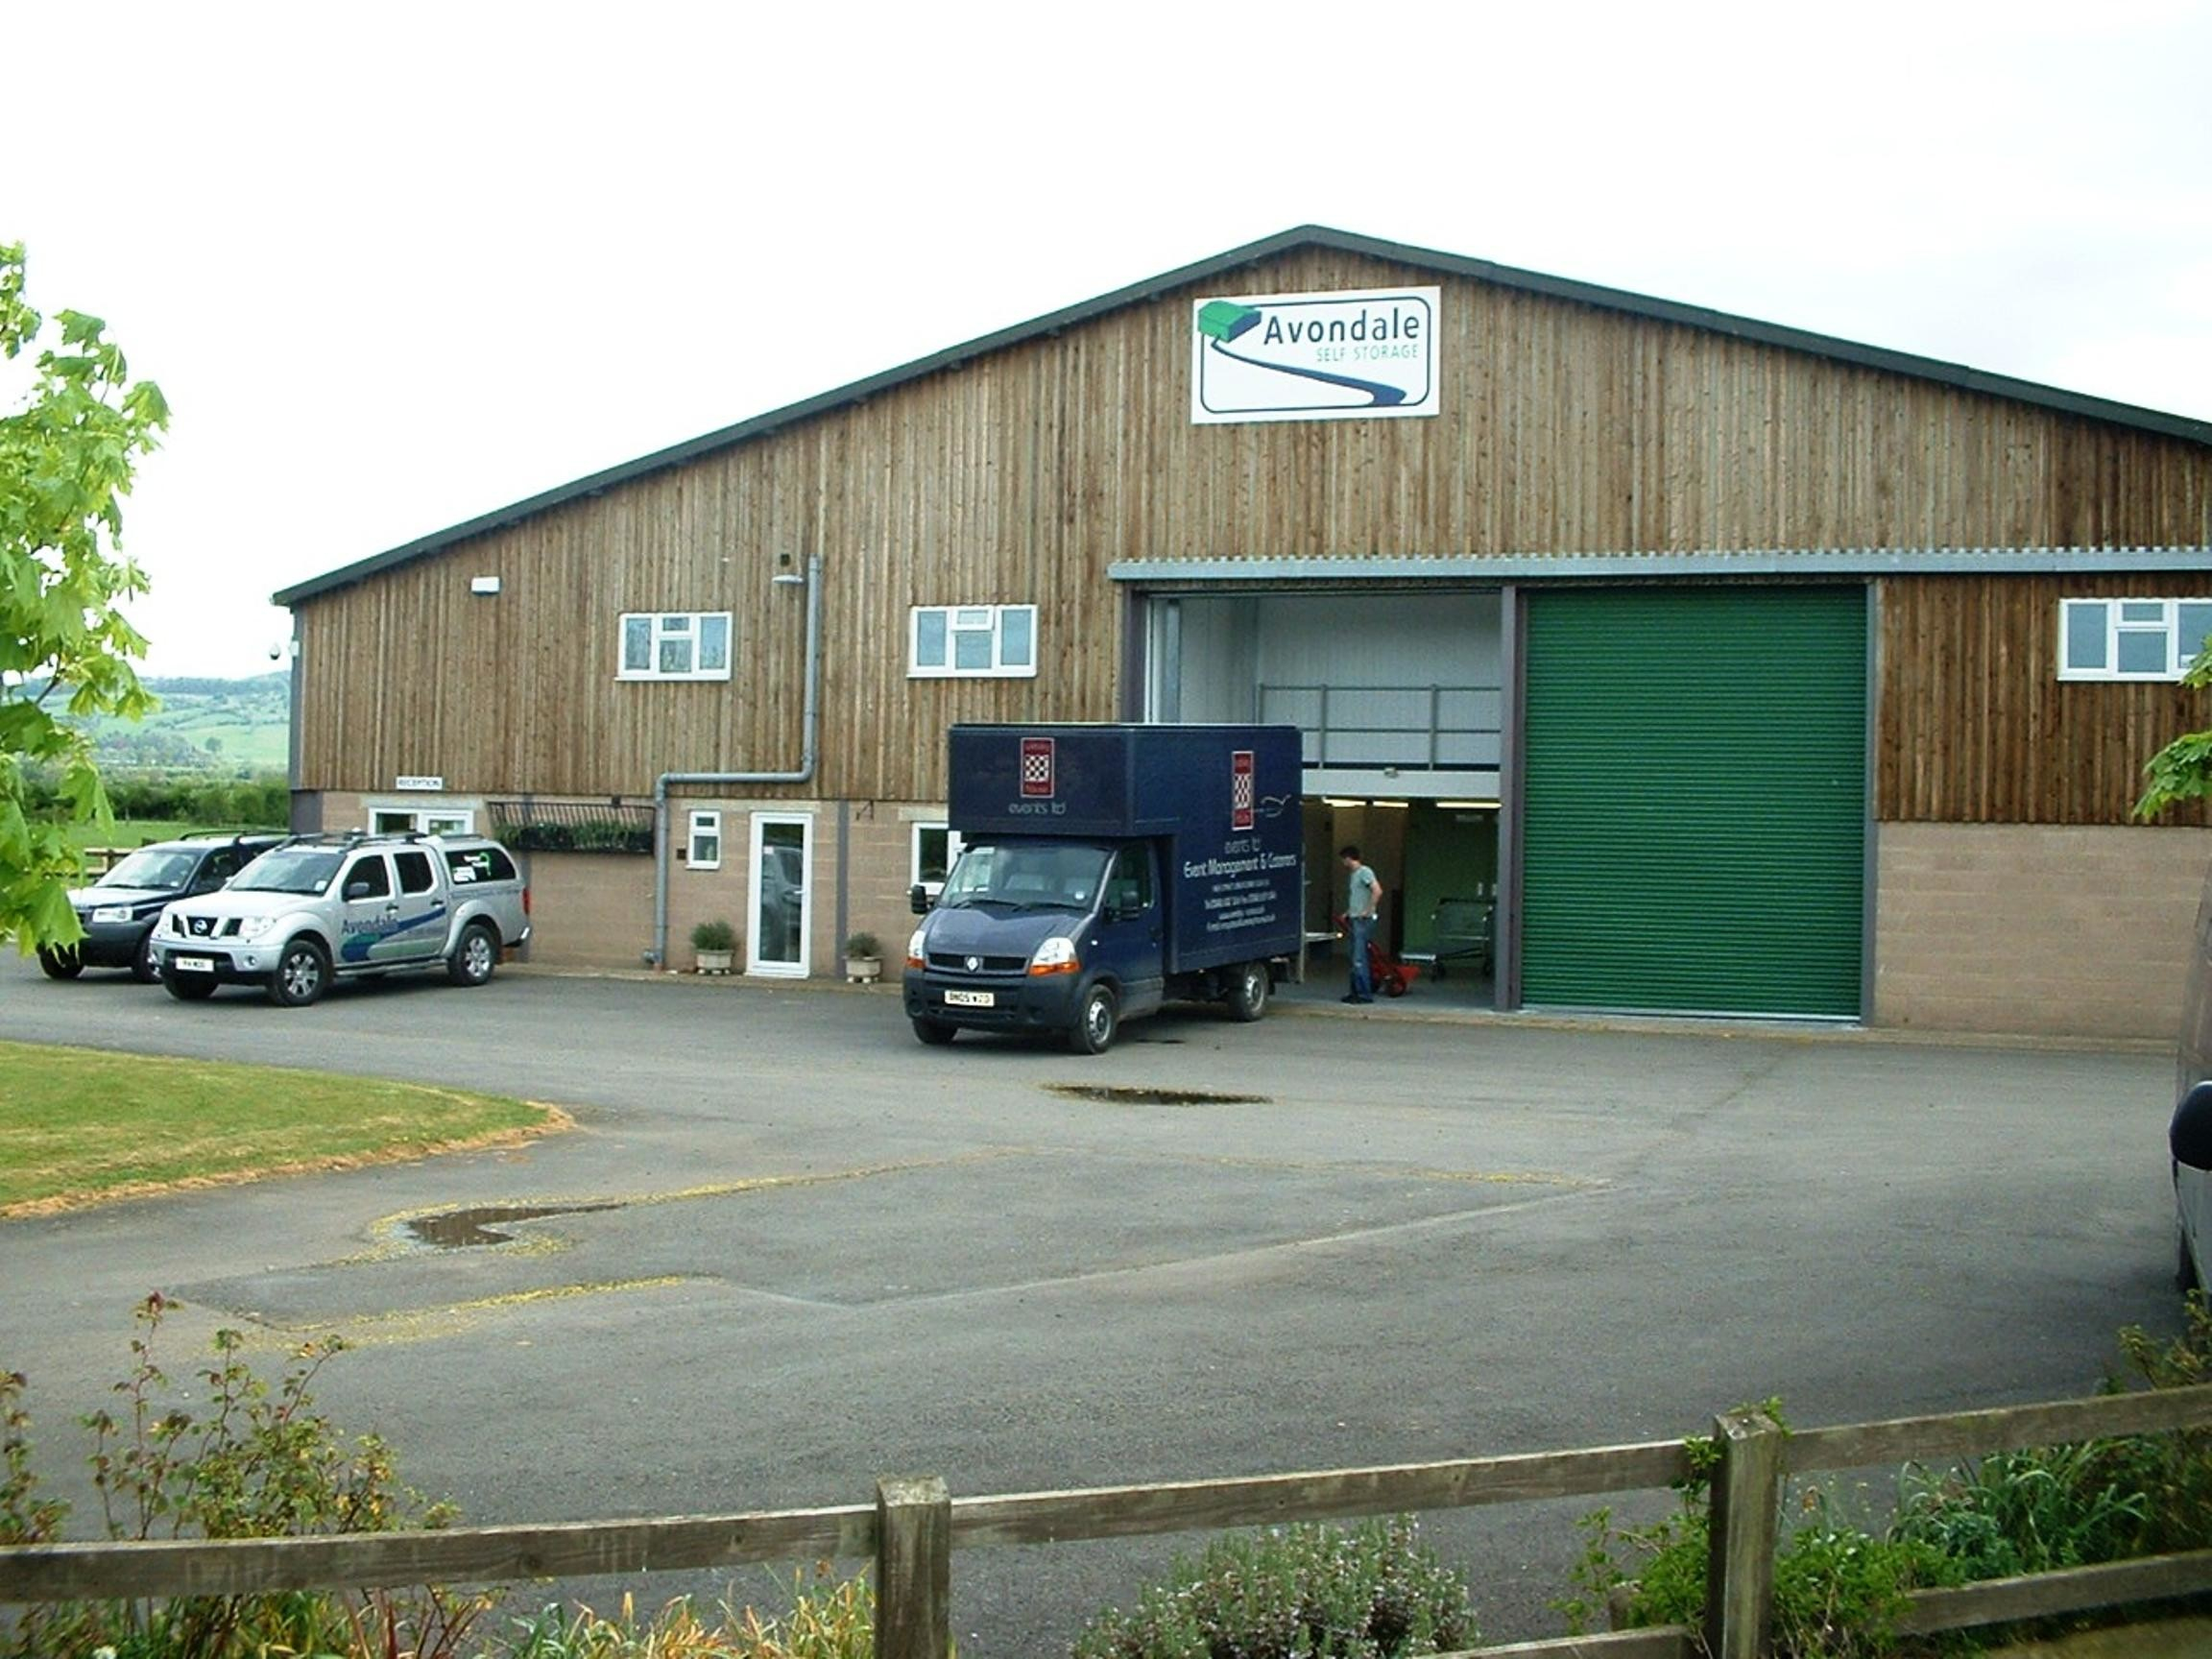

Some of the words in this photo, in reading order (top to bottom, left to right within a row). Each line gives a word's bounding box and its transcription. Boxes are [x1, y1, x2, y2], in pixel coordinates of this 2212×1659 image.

[1263, 307, 1420, 345] Avondale
[1316, 346, 1346, 362] SELF
[1354, 344, 1419, 361] STORAGE
[398, 779, 440, 787] RECEPTION
[342, 914, 400, 934] Avondale
